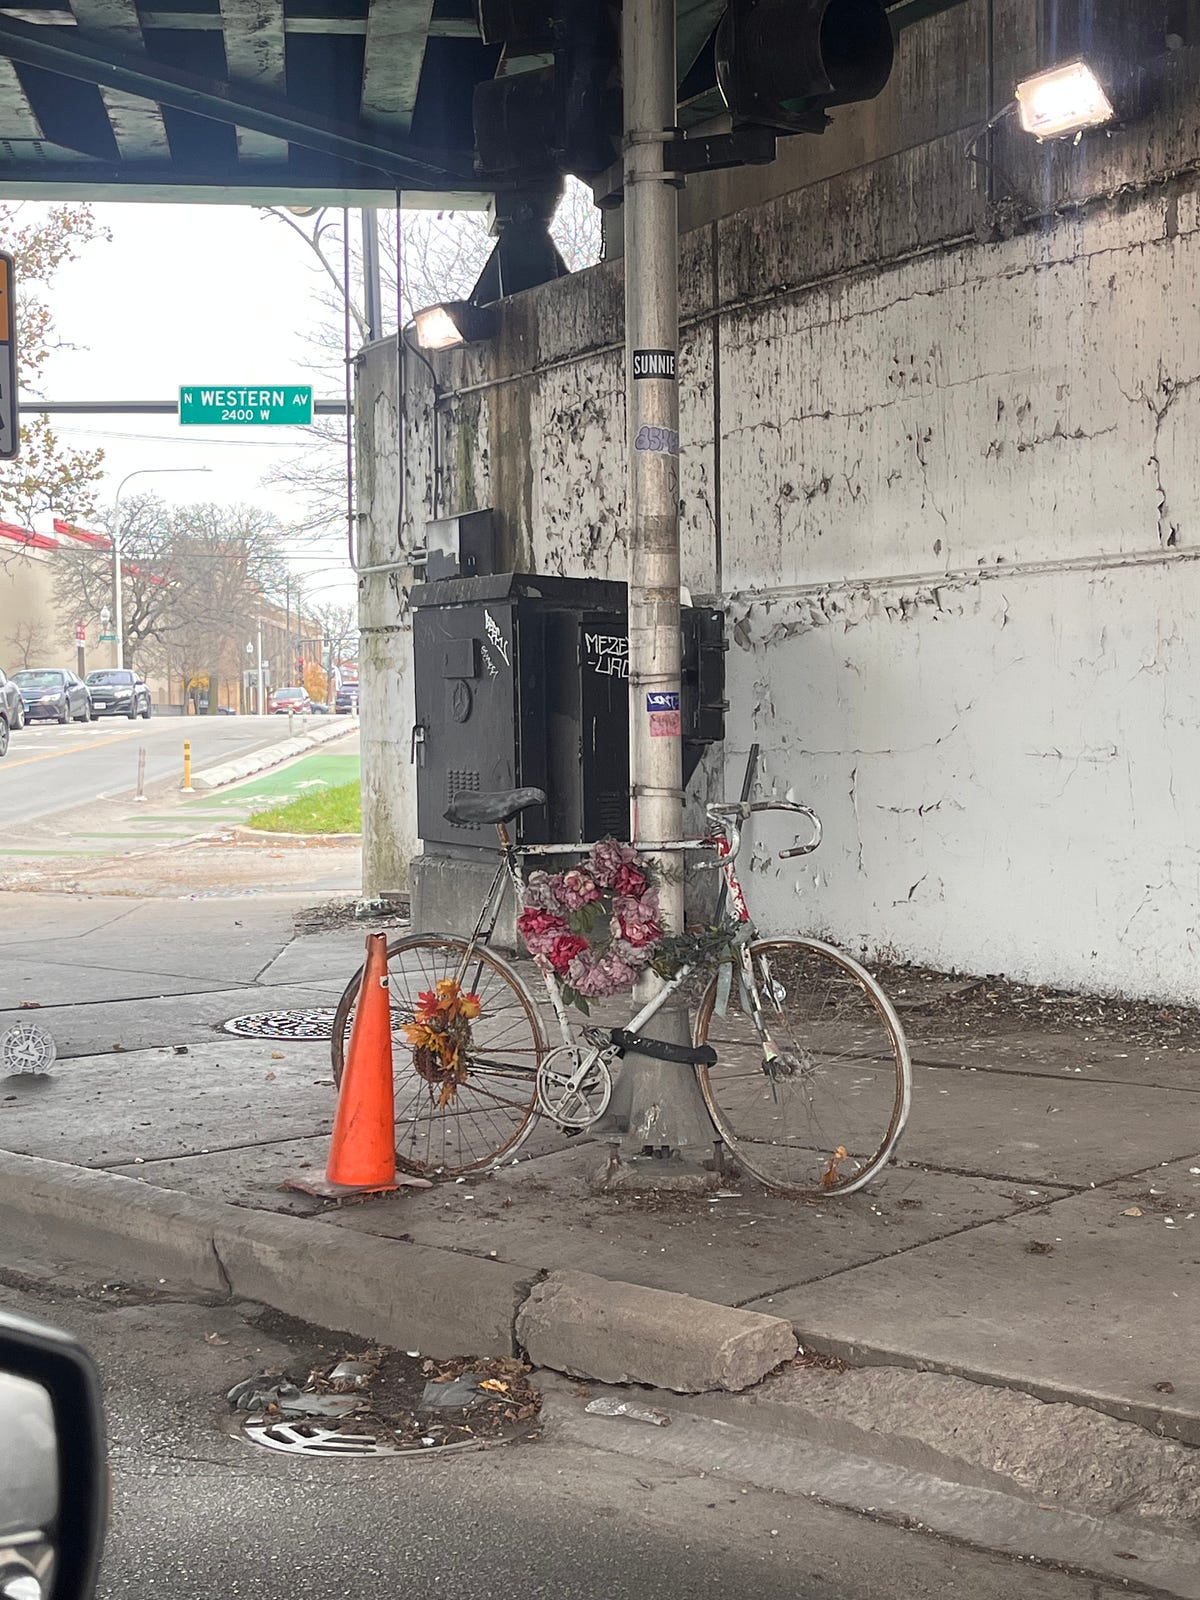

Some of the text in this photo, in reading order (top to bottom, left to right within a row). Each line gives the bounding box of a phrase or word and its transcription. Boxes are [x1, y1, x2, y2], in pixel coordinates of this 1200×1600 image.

[634, 354, 675, 375] SUNNIE
[184, 390, 308, 407] N WESTERN AV
[221, 409, 271, 421] 2400 W
